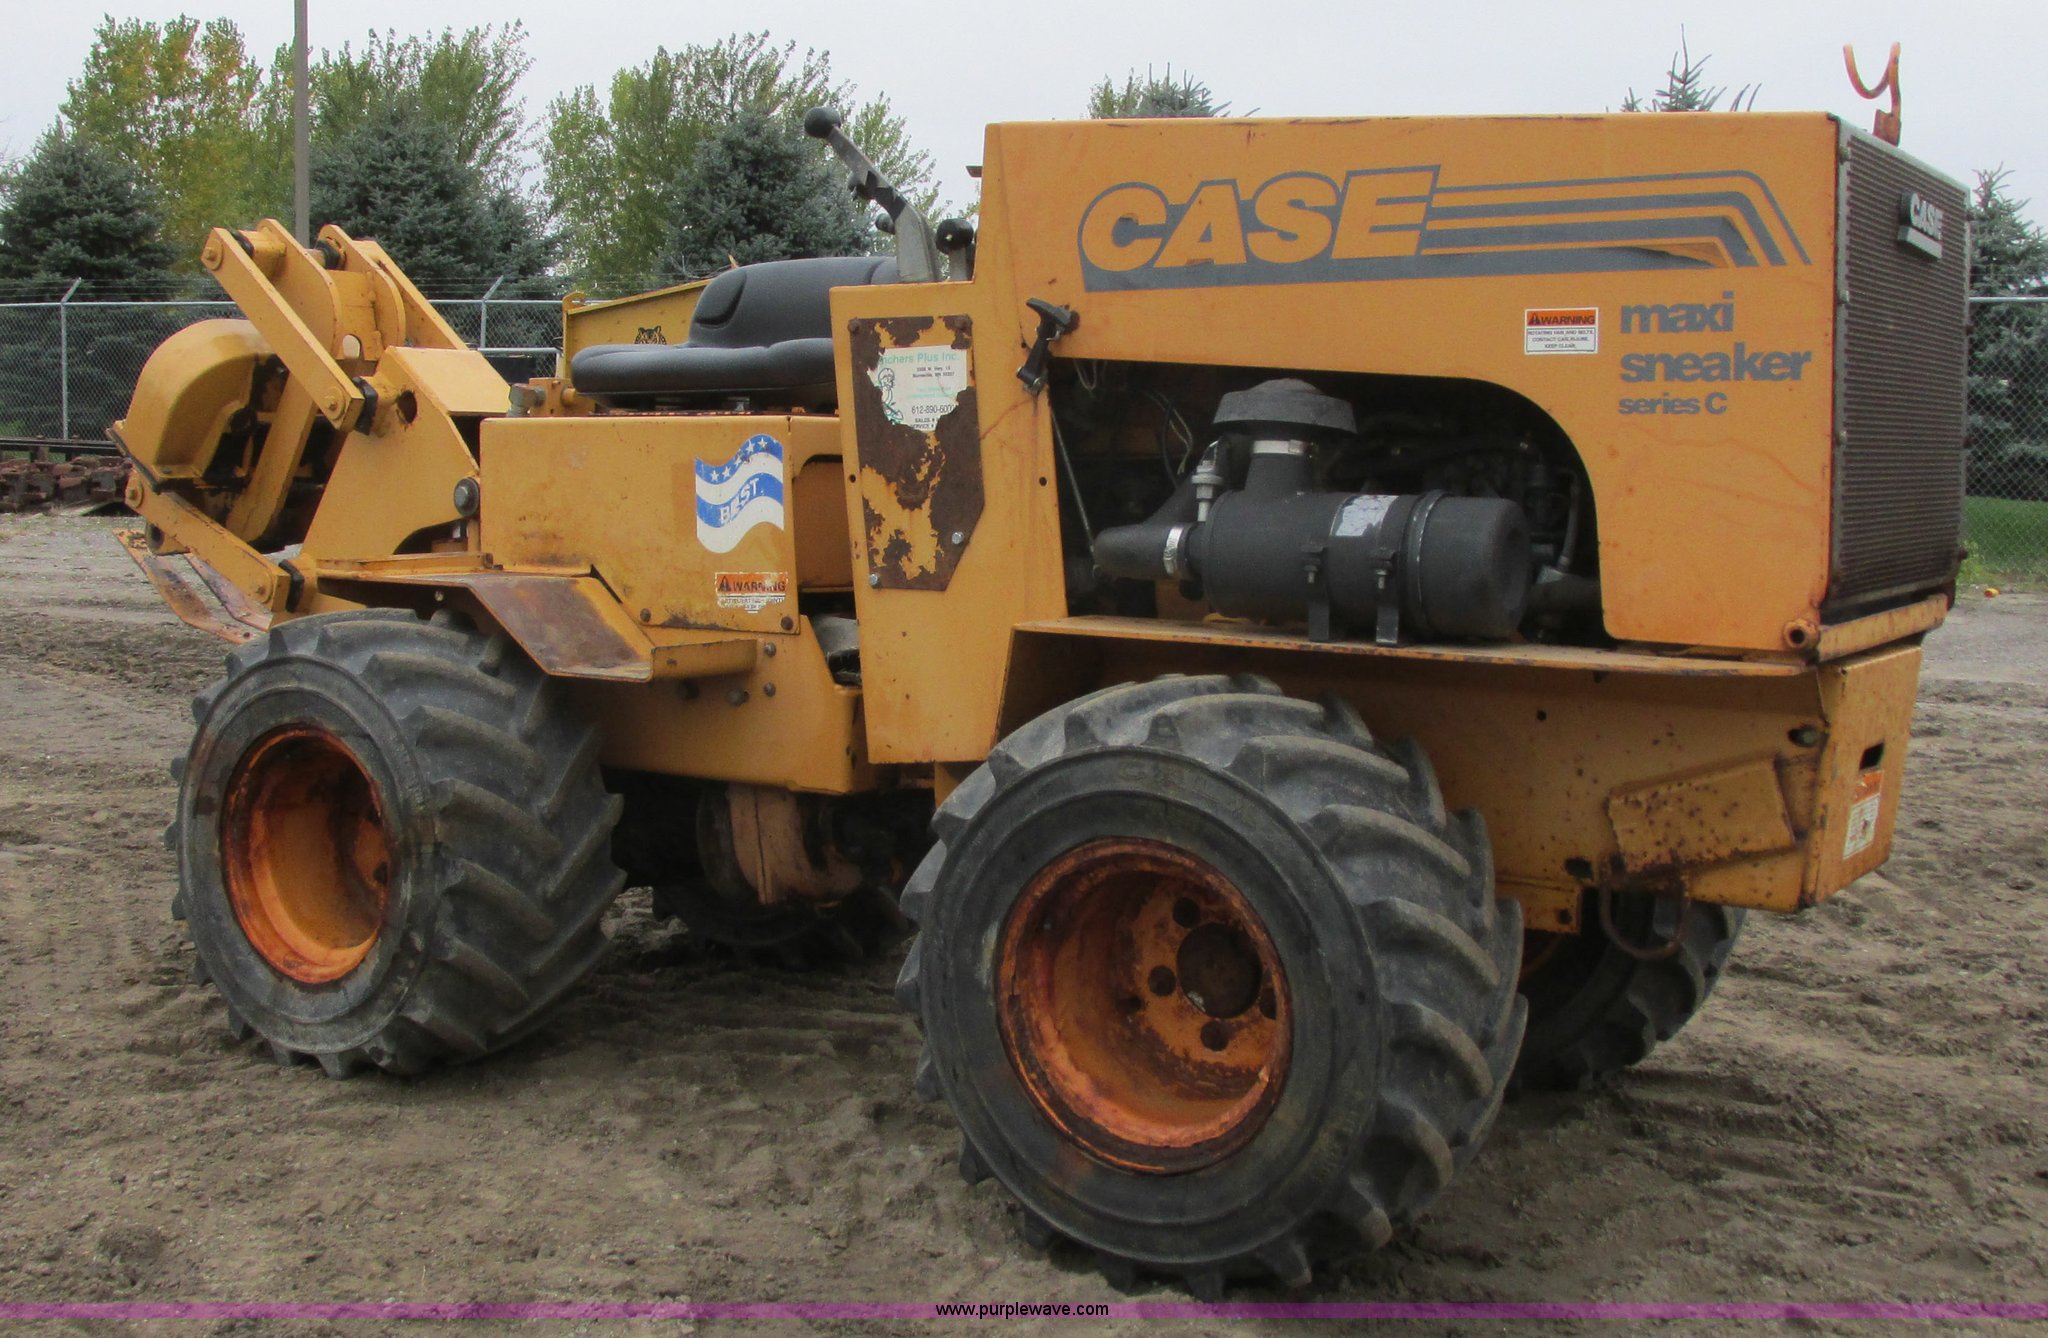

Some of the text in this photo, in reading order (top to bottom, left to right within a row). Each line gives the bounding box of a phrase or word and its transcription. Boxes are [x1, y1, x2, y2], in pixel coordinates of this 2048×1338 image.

[1078, 166, 1440, 272] CASE
[1911, 192, 1943, 240] CASE
[1541, 315, 1596, 326] WARNING
[1620, 291, 1735, 334] maxi
[917, 352, 939, 362] Plus
[1619, 342, 1812, 382] sneaker
[1618, 391, 1728, 414] series C
[719, 477, 760, 526] BEST
